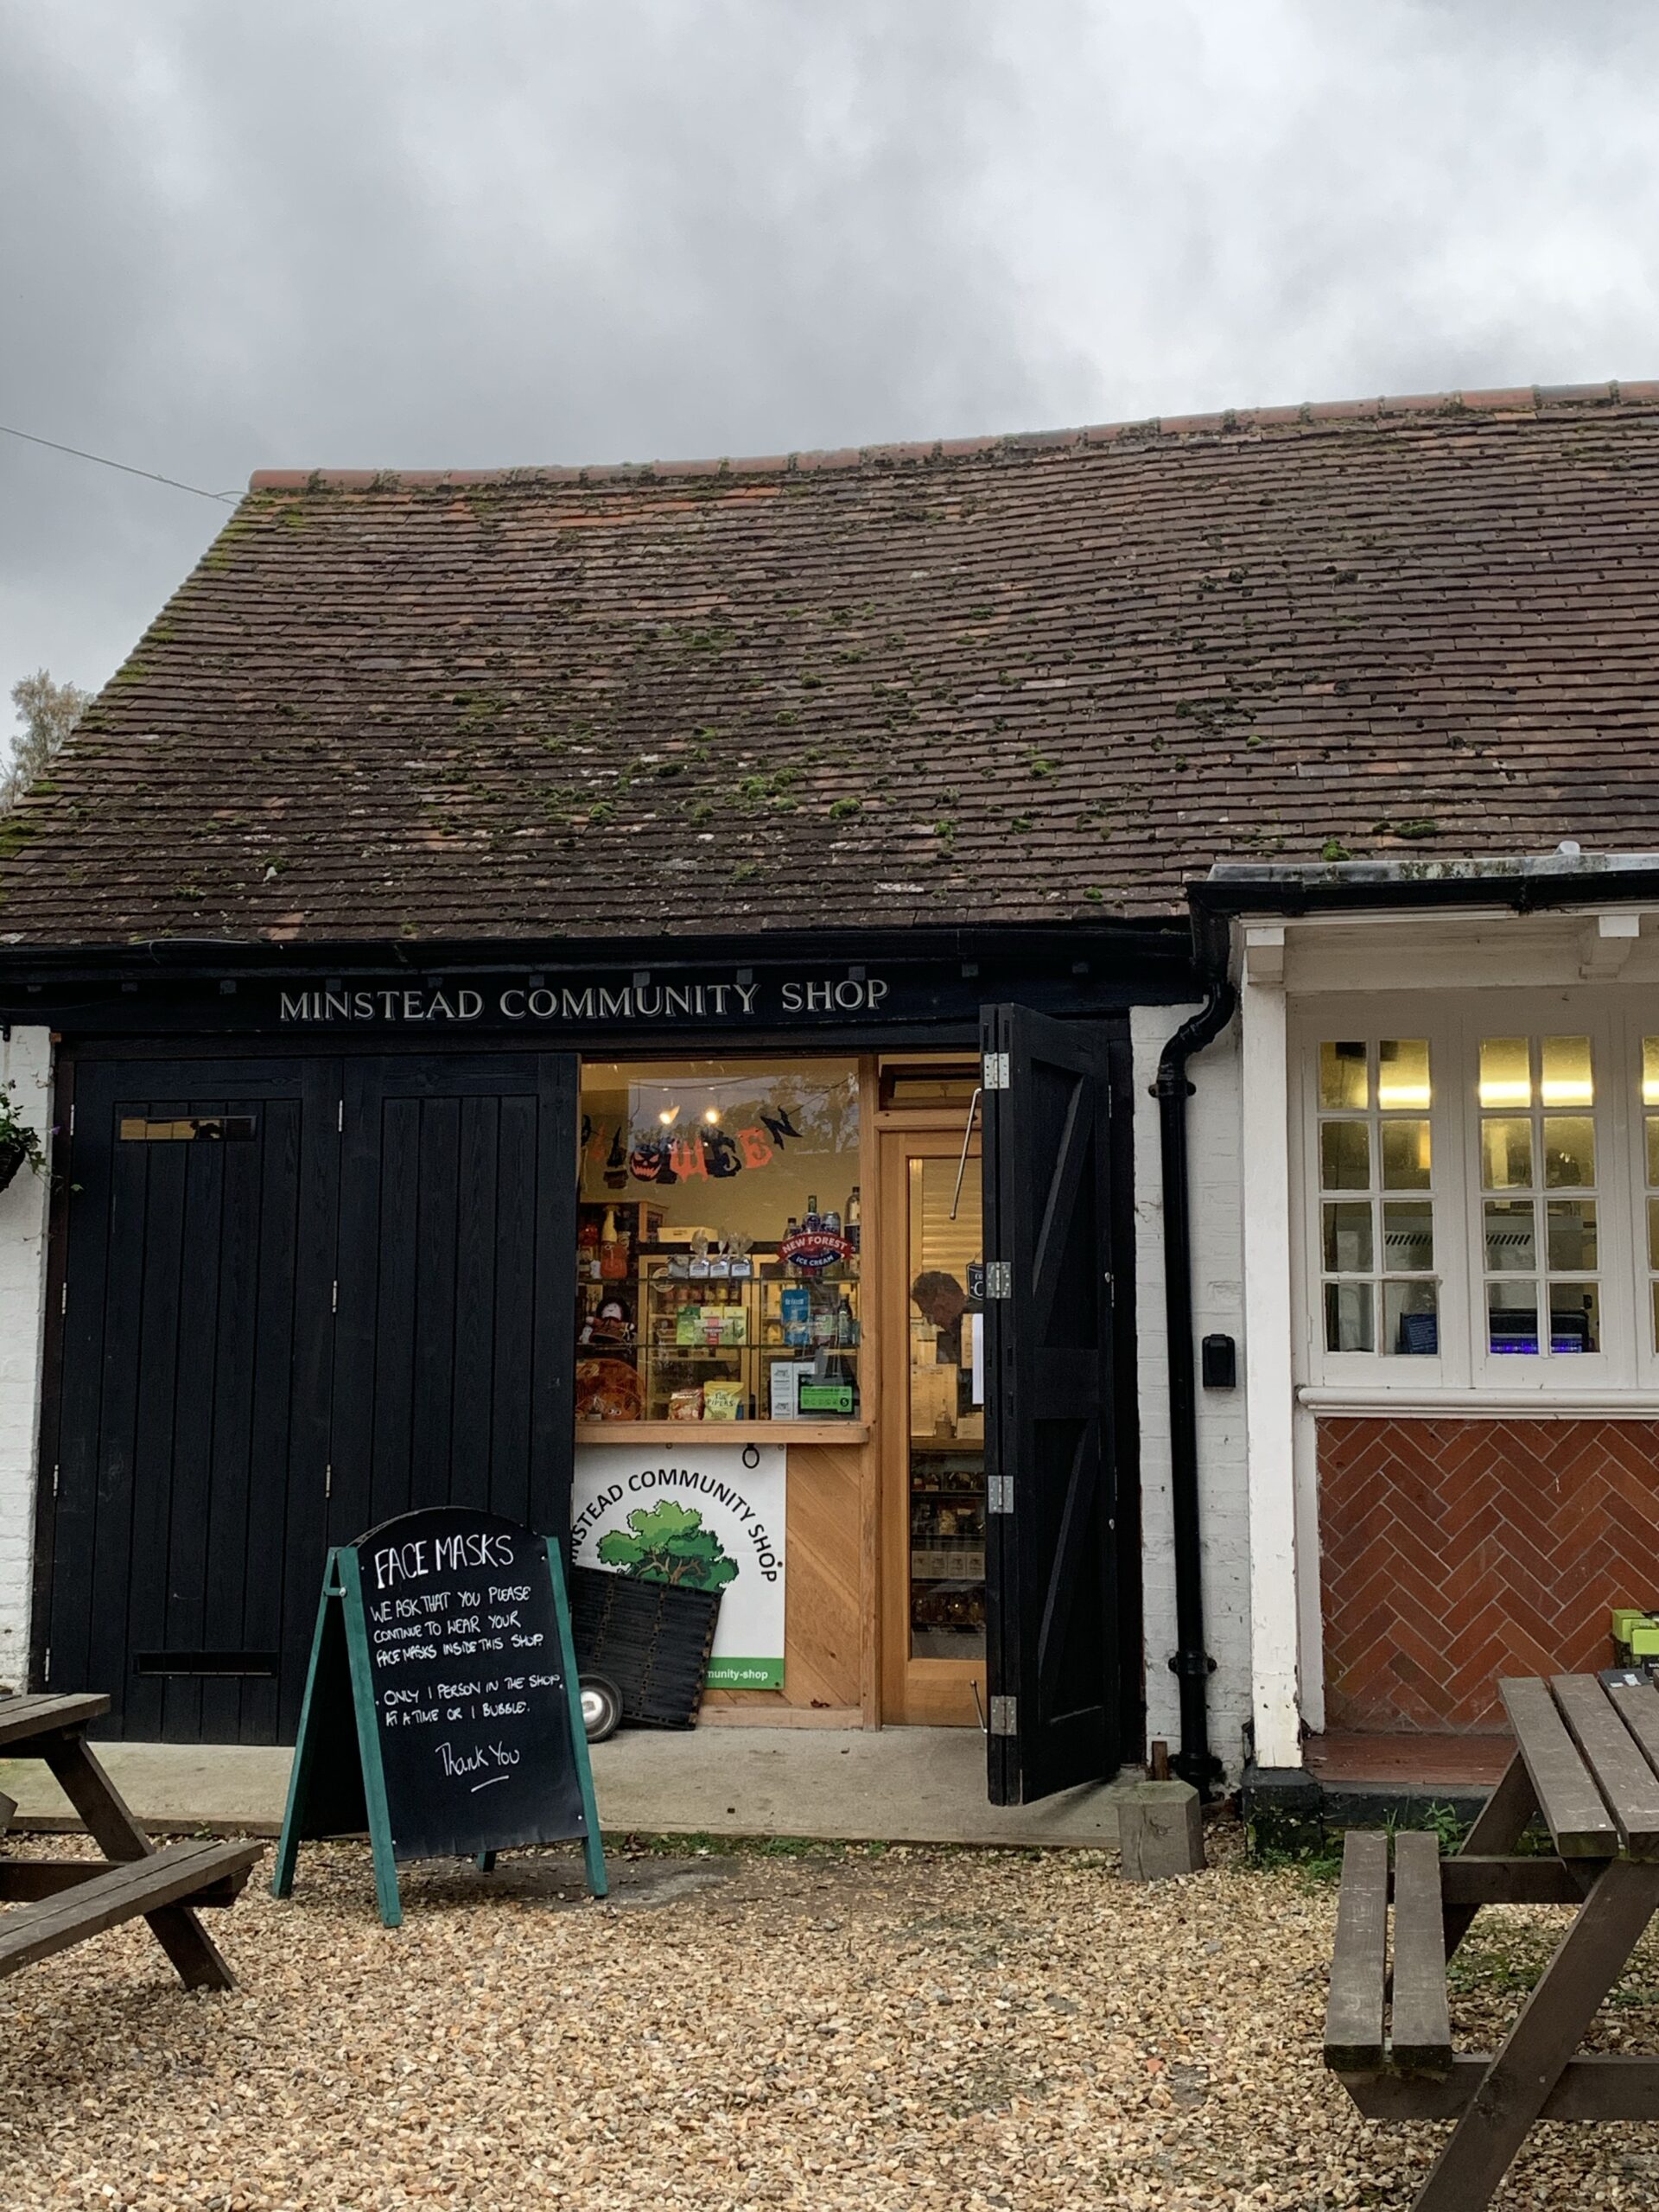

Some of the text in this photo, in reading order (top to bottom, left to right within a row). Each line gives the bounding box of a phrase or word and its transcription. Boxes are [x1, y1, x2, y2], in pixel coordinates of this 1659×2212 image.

[280, 979, 888, 1021] MINSTEAD COMMUNITY SHOP
[782, 1236, 848, 1254] NEW FOREST
[796, 1255, 835, 1267] ICE CREAM
[628, 1468, 756, 1522] COMMUNITY
[748, 1523, 778, 1583] SHOP
[374, 1534, 514, 1589] FACE MASKS
[370, 1586, 531, 1624] WE ASK THAT YOU PLEASE
[373, 1610, 522, 1643] CONTINUE TO WEAR YOUR
[376, 1649, 401, 1668] FACE
[403, 1643, 437, 1662] MASKS
[442, 1640, 477, 1656] INSIDE
[477, 1637, 504, 1652] THIS
[384, 1689, 420, 1706] ONLY
[437, 1681, 480, 1700] PERSON
[486, 1680, 499, 1694] IN
[504, 1676, 525, 1690] THE
[385, 1710, 398, 1726] AT
[403, 1711, 411, 1726] A
[411, 1709, 440, 1724] TIME
[447, 1707, 463, 1721] OR
[435, 1740, 520, 1776] Thank You
